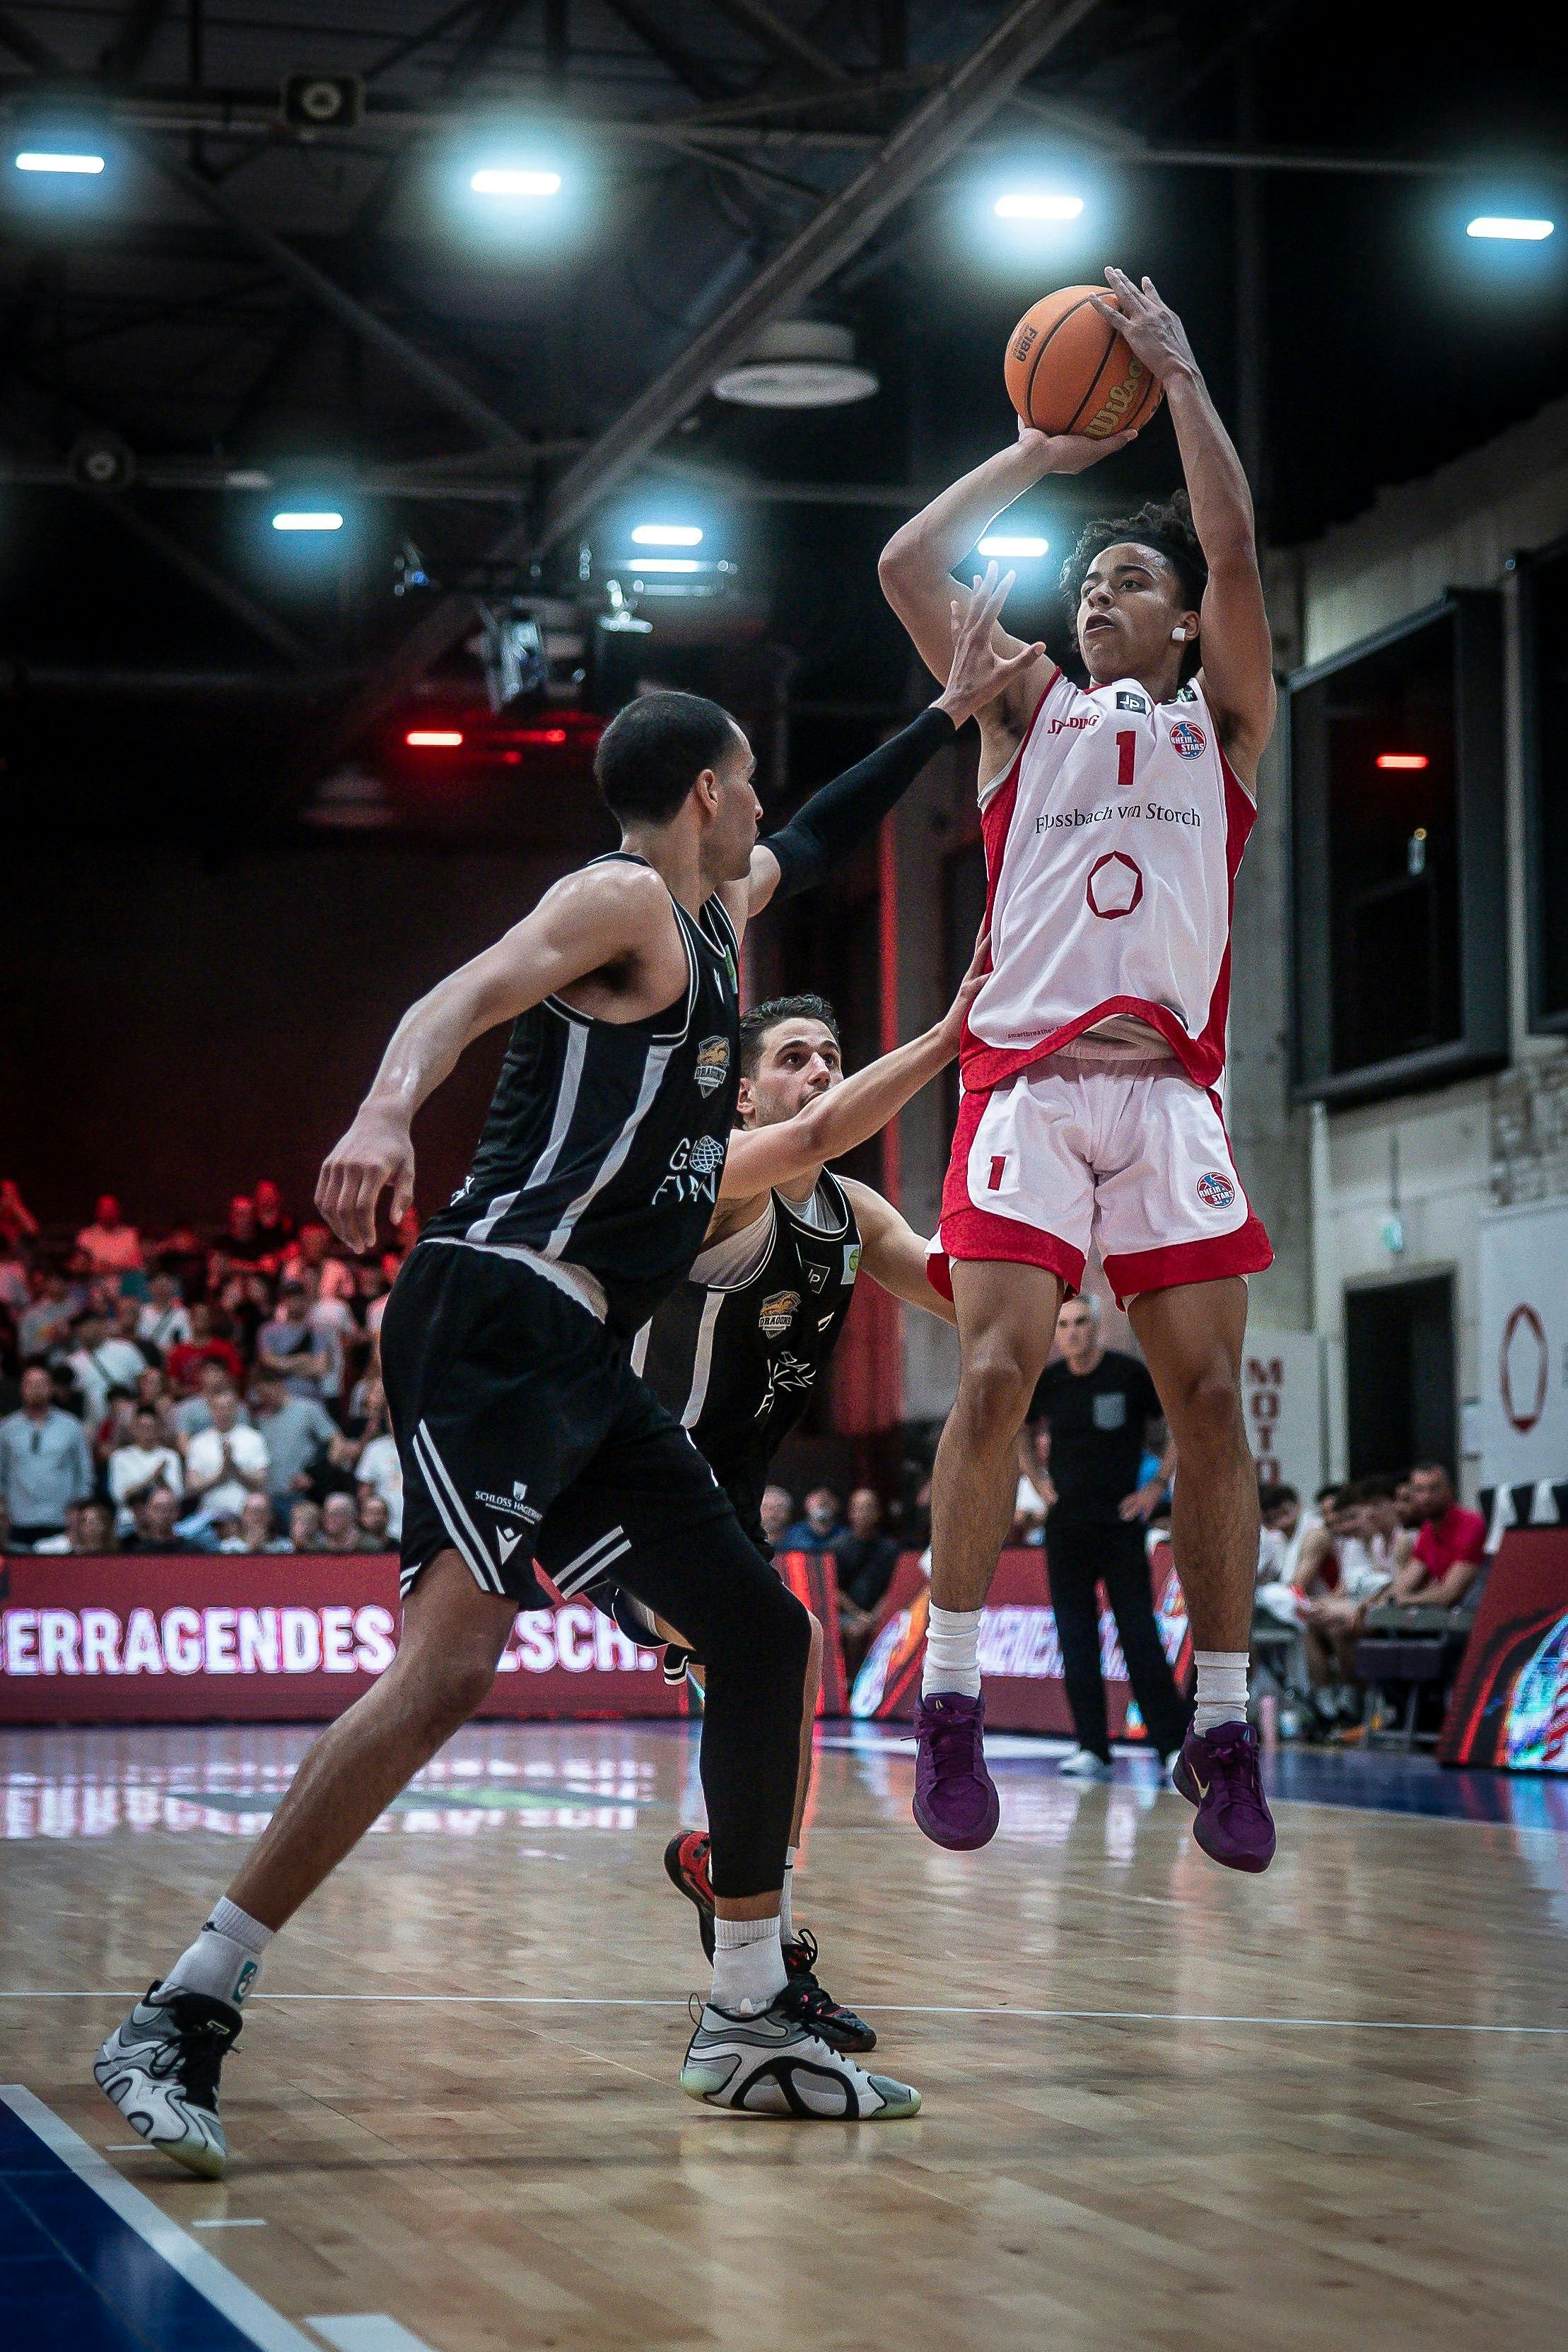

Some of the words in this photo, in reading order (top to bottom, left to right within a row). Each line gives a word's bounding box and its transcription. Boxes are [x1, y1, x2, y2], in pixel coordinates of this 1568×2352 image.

[1084, 356, 1143, 437] Wilso
[1171, 736, 1193, 744] RHEIN
[1181, 743, 1204, 751] STARS
[1116, 730, 1136, 785] 1
[1146, 802, 1201, 827] Storch
[988, 1156, 1007, 1190] 1
[475, 1490, 512, 1507] SCHLOSS
[0, 1605, 397, 1675] ERRAGENDES
